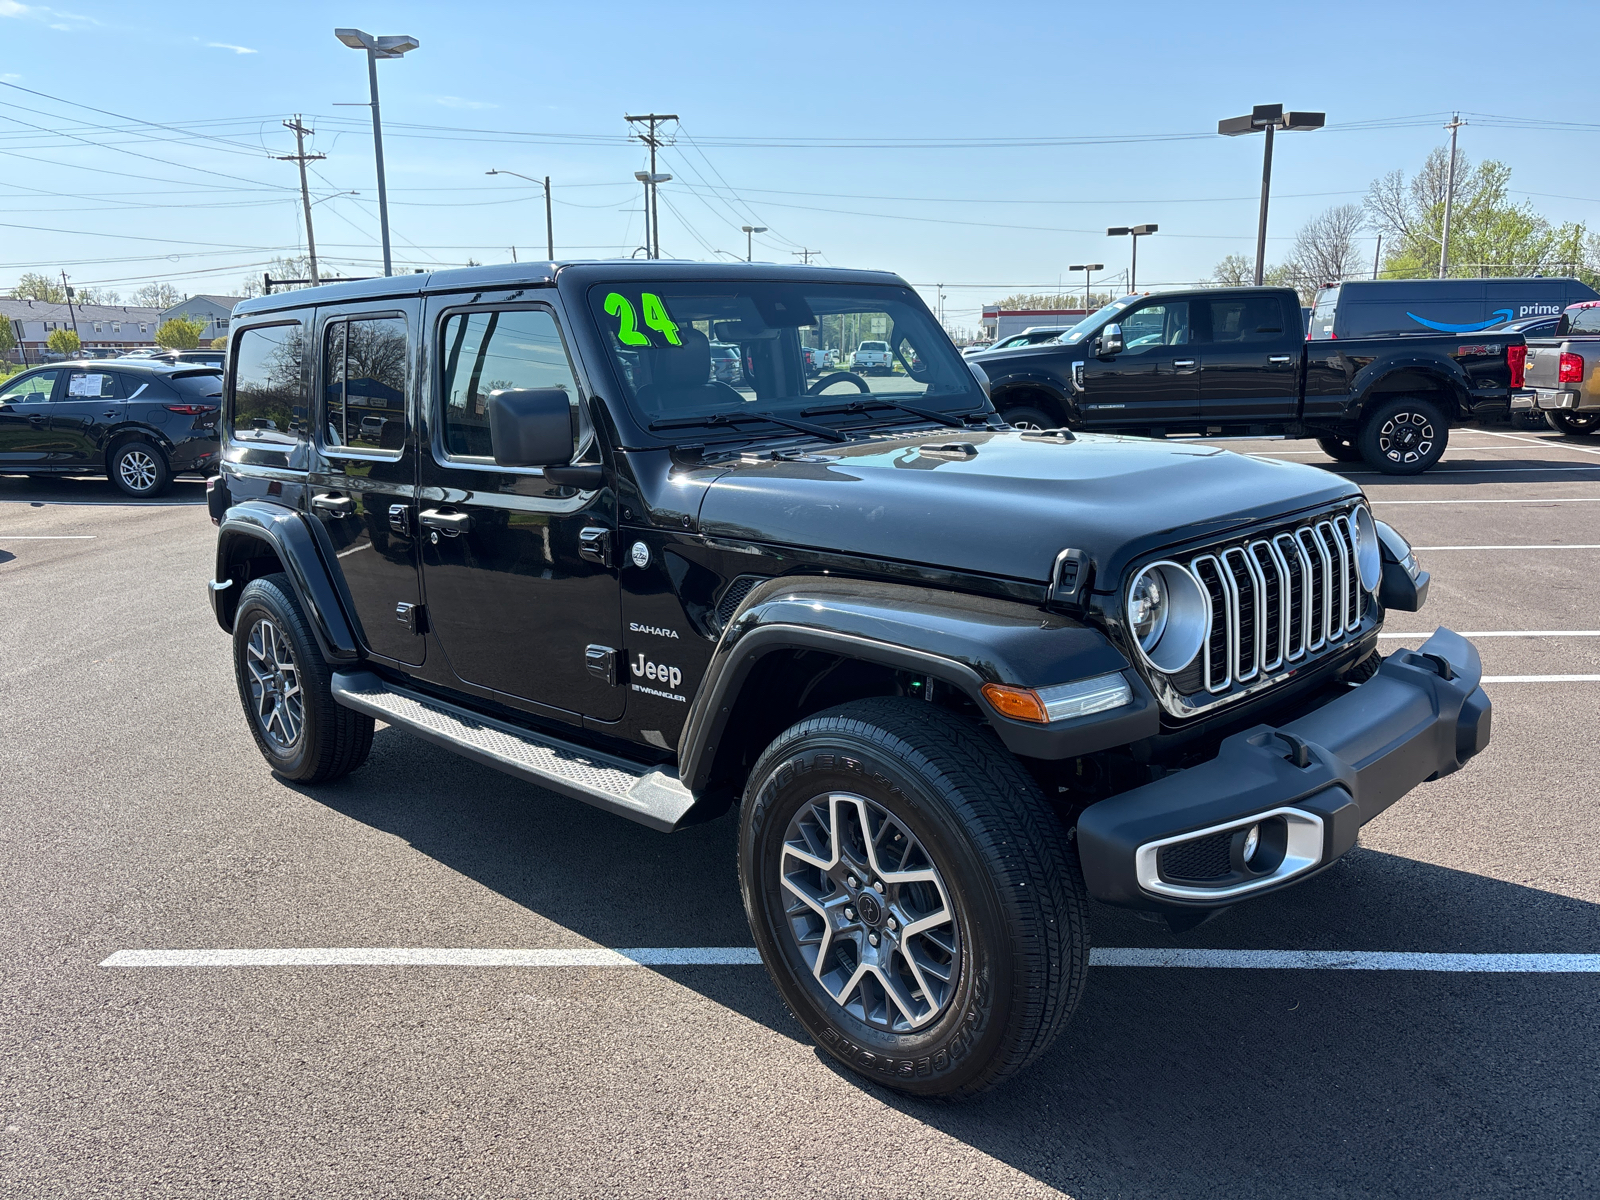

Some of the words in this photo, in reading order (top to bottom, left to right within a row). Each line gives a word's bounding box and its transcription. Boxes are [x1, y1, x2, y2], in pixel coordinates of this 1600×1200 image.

[1519, 303, 1560, 317] prime
[604, 292, 683, 347] 24
[1458, 344, 1501, 356] FX4
[629, 622, 680, 640] SAHARA
[631, 653, 682, 689] Jeep
[639, 685, 687, 703] WRANGLER
[752, 753, 866, 836] DUELER
